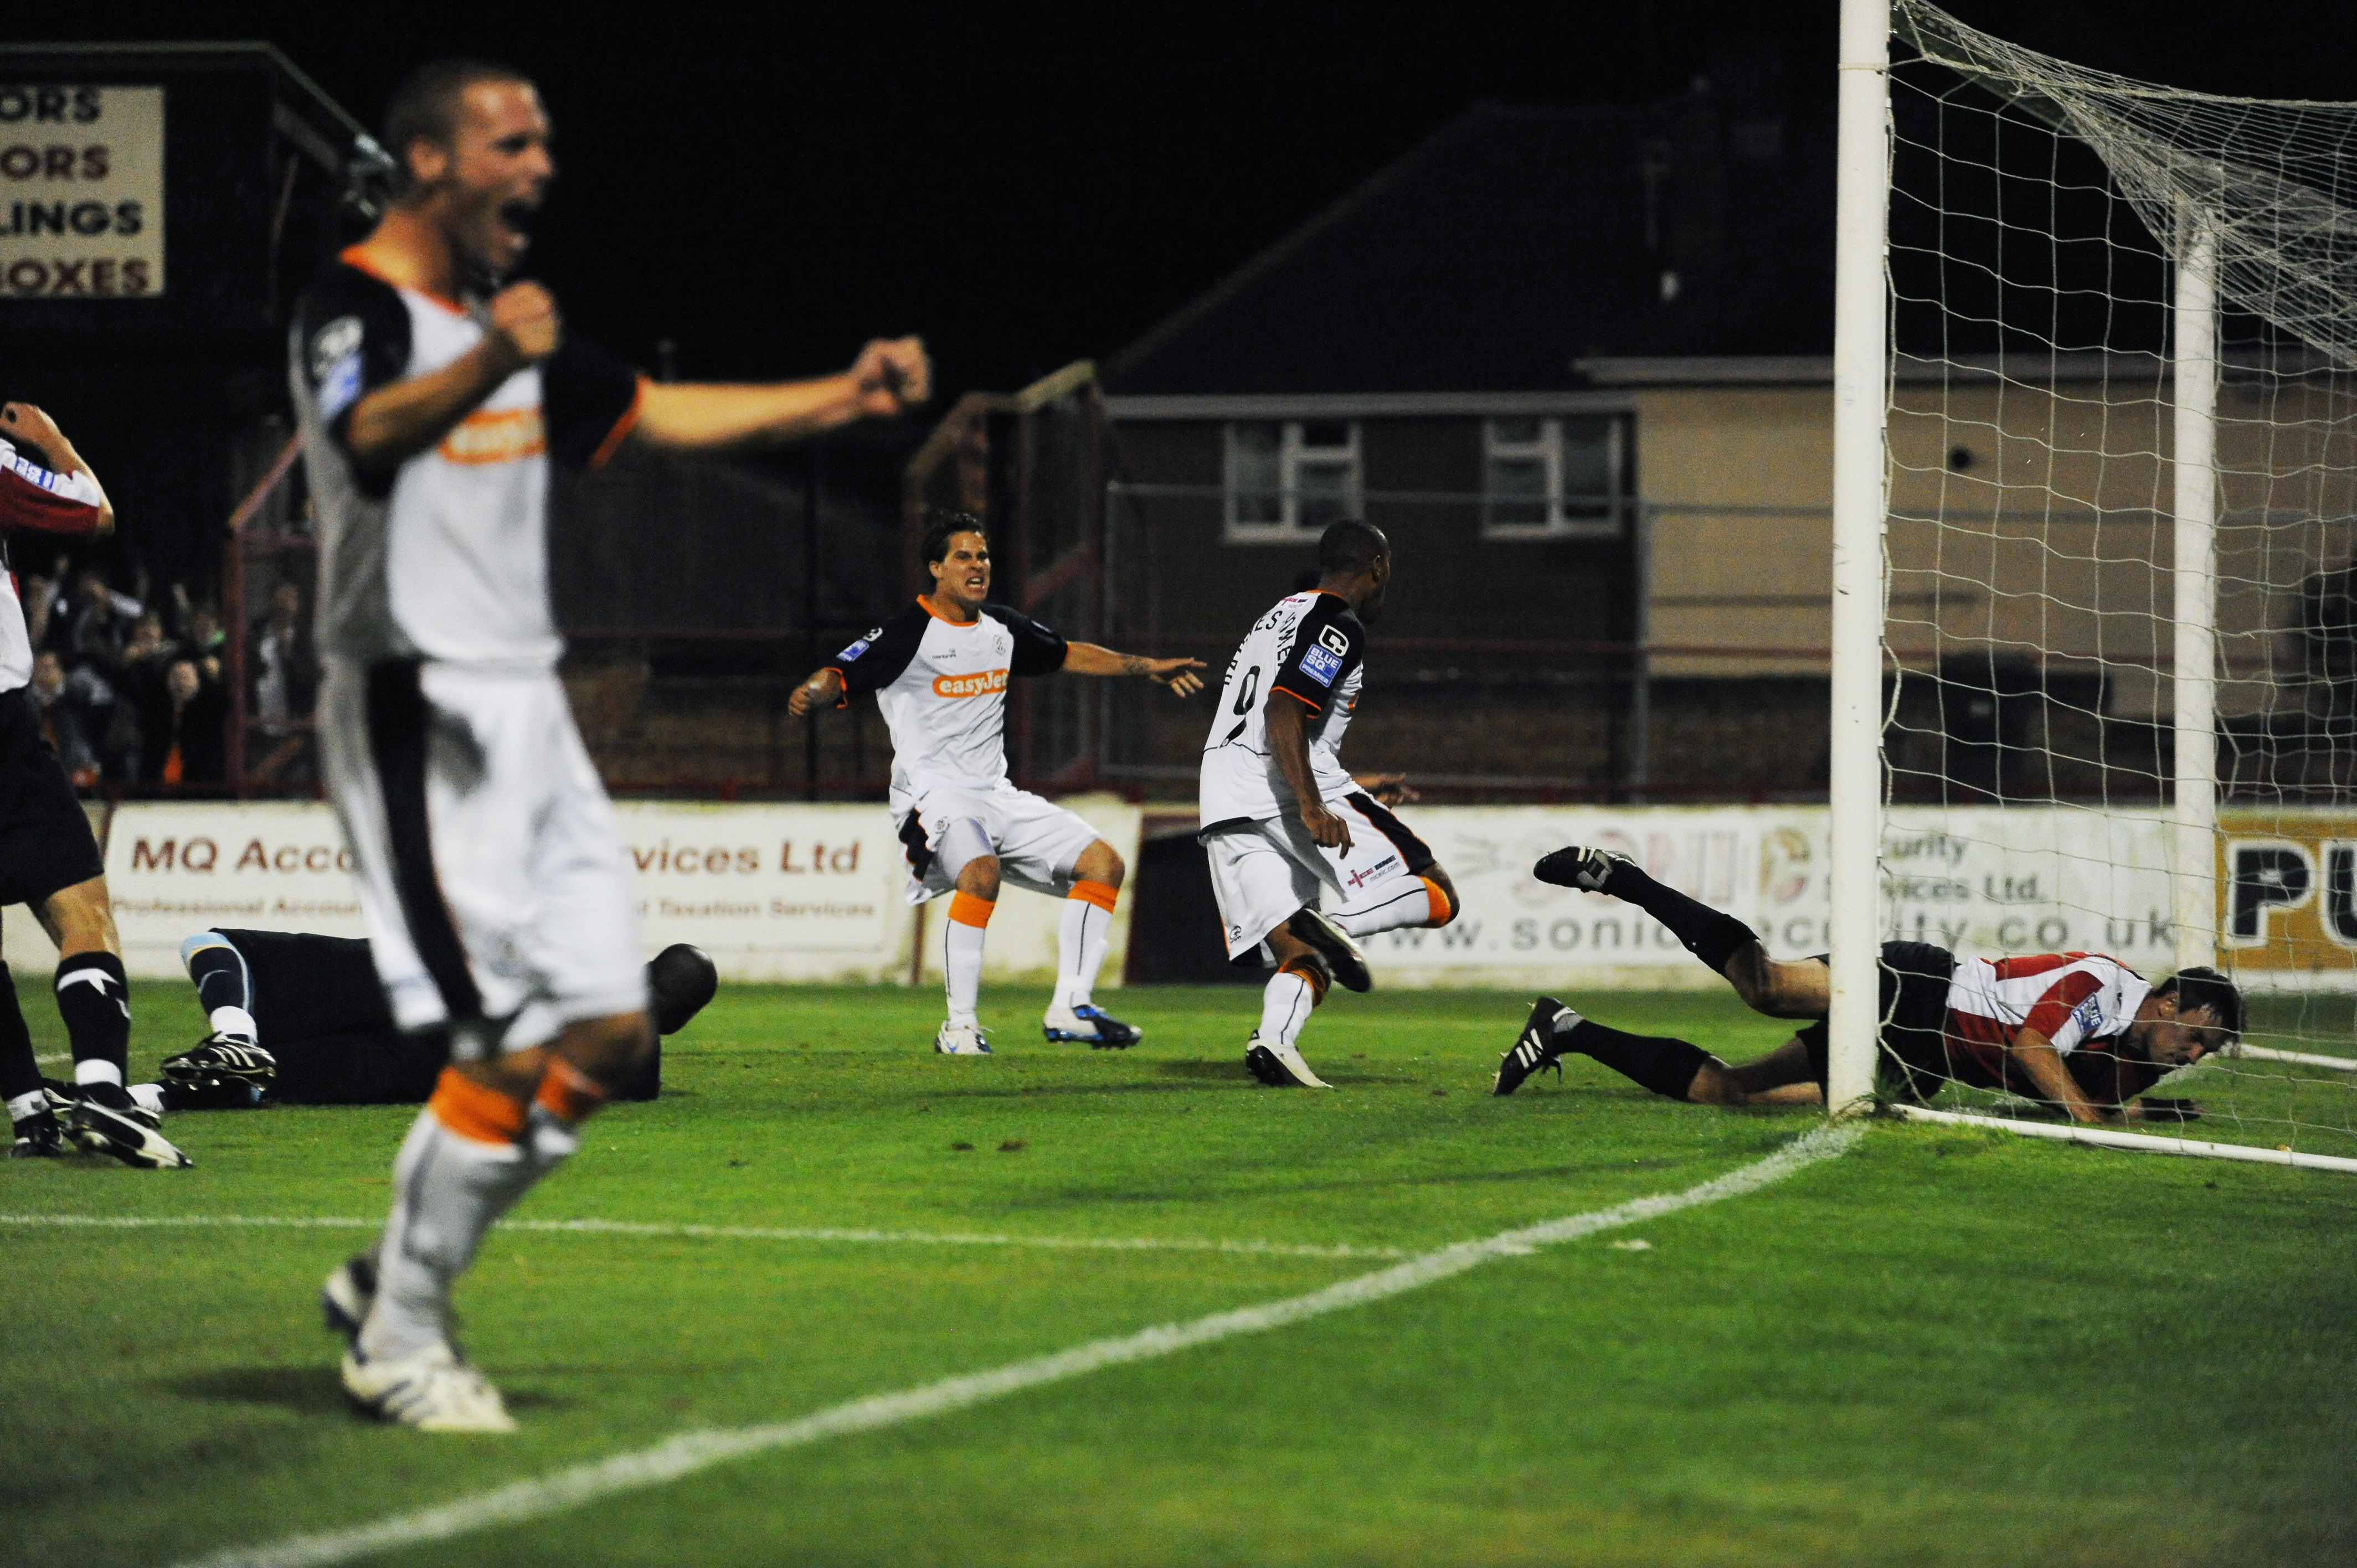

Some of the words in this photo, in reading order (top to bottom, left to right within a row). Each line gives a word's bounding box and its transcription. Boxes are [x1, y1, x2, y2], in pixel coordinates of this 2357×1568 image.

[0, 144, 109, 181] ORS
[0, 258, 150, 294] OXES
[1306, 654, 1325, 670] SQ
[1310, 647, 1339, 669] BLUE
[939, 671, 1008, 695] easyJet
[1302, 664, 1329, 684] PREMIER
[132, 837, 219, 873] MQ
[780, 836, 862, 874] Ltd
